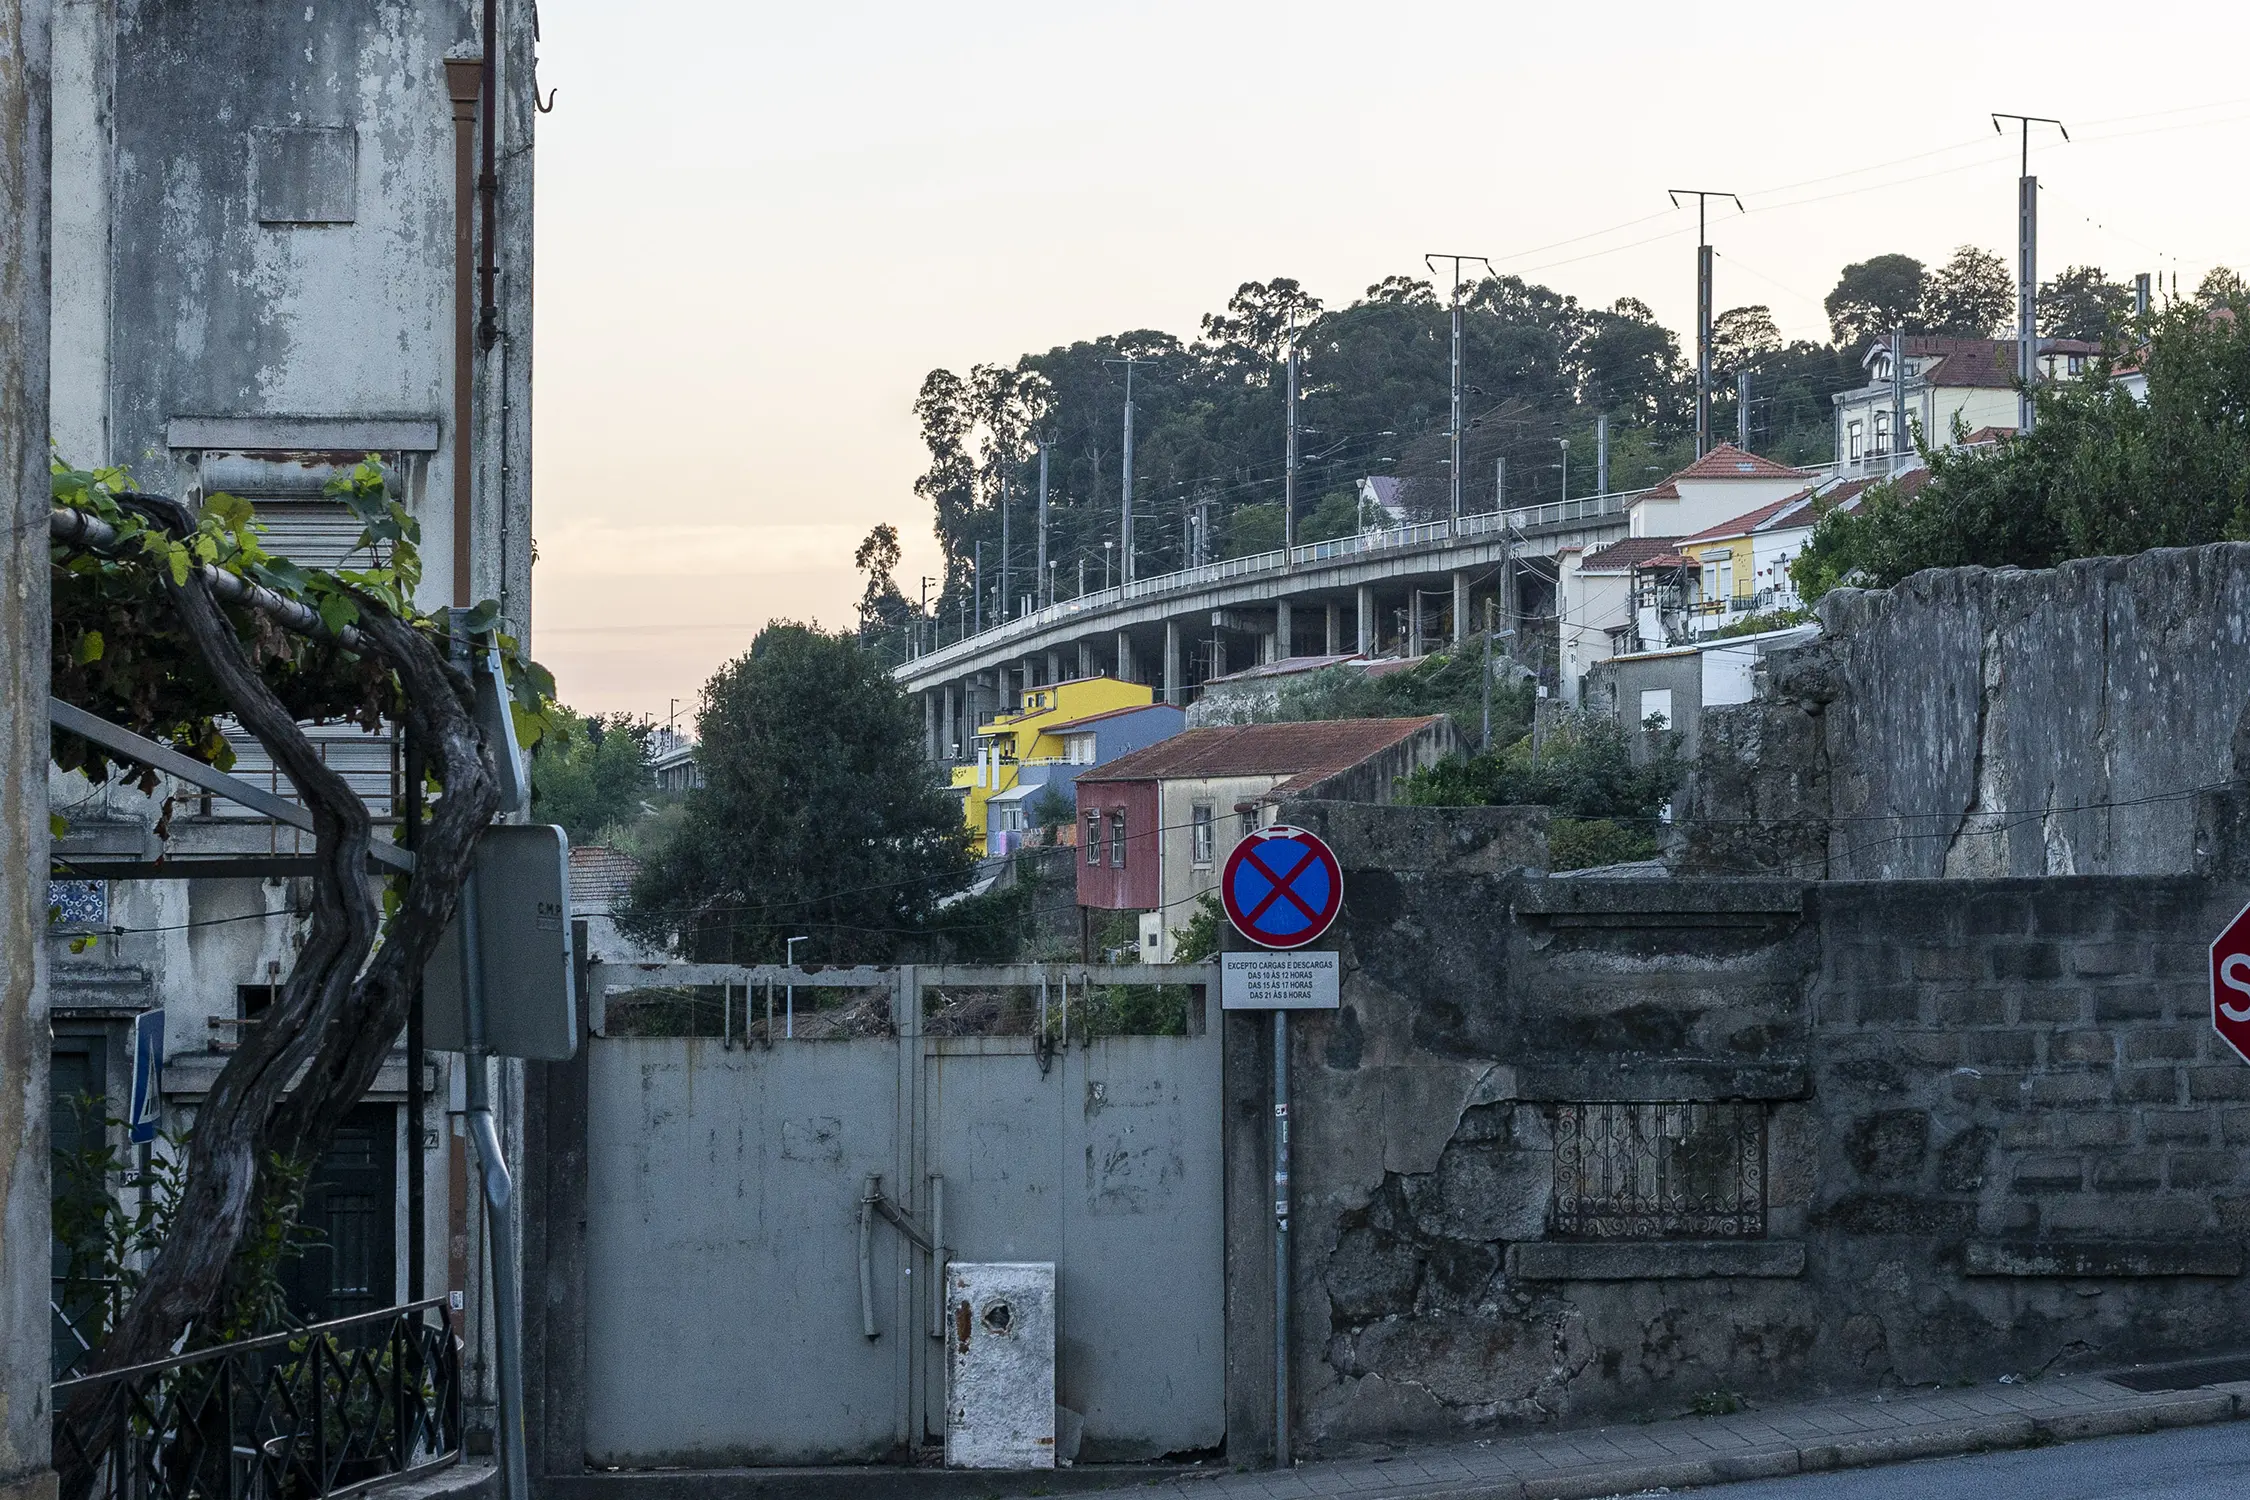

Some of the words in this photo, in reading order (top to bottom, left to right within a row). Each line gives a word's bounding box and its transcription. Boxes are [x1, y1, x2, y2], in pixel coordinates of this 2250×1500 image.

[1227, 962, 1258, 970] EXCEPTO
[1259, 961, 1286, 970] CARGAS
[1287, 961, 1292, 969] E
[1293, 961, 1333, 969] DESCARGAS
[1248, 971, 1262, 979] DAS
[1263, 971, 1270, 979] 10
[1282, 971, 1289, 979] 12
[1290, 971, 1313, 979] HORAS
[1248, 981, 1262, 989] DAS
[1263, 981, 1270, 989] 15
[1282, 981, 1289, 989] 17
[1290, 981, 1313, 989] HORAS
[1250, 991, 1264, 999] DAS
[1264, 991, 1271, 999] 21
[1283, 991, 1288, 999] 8
[1289, 991, 1312, 999] HORAS
